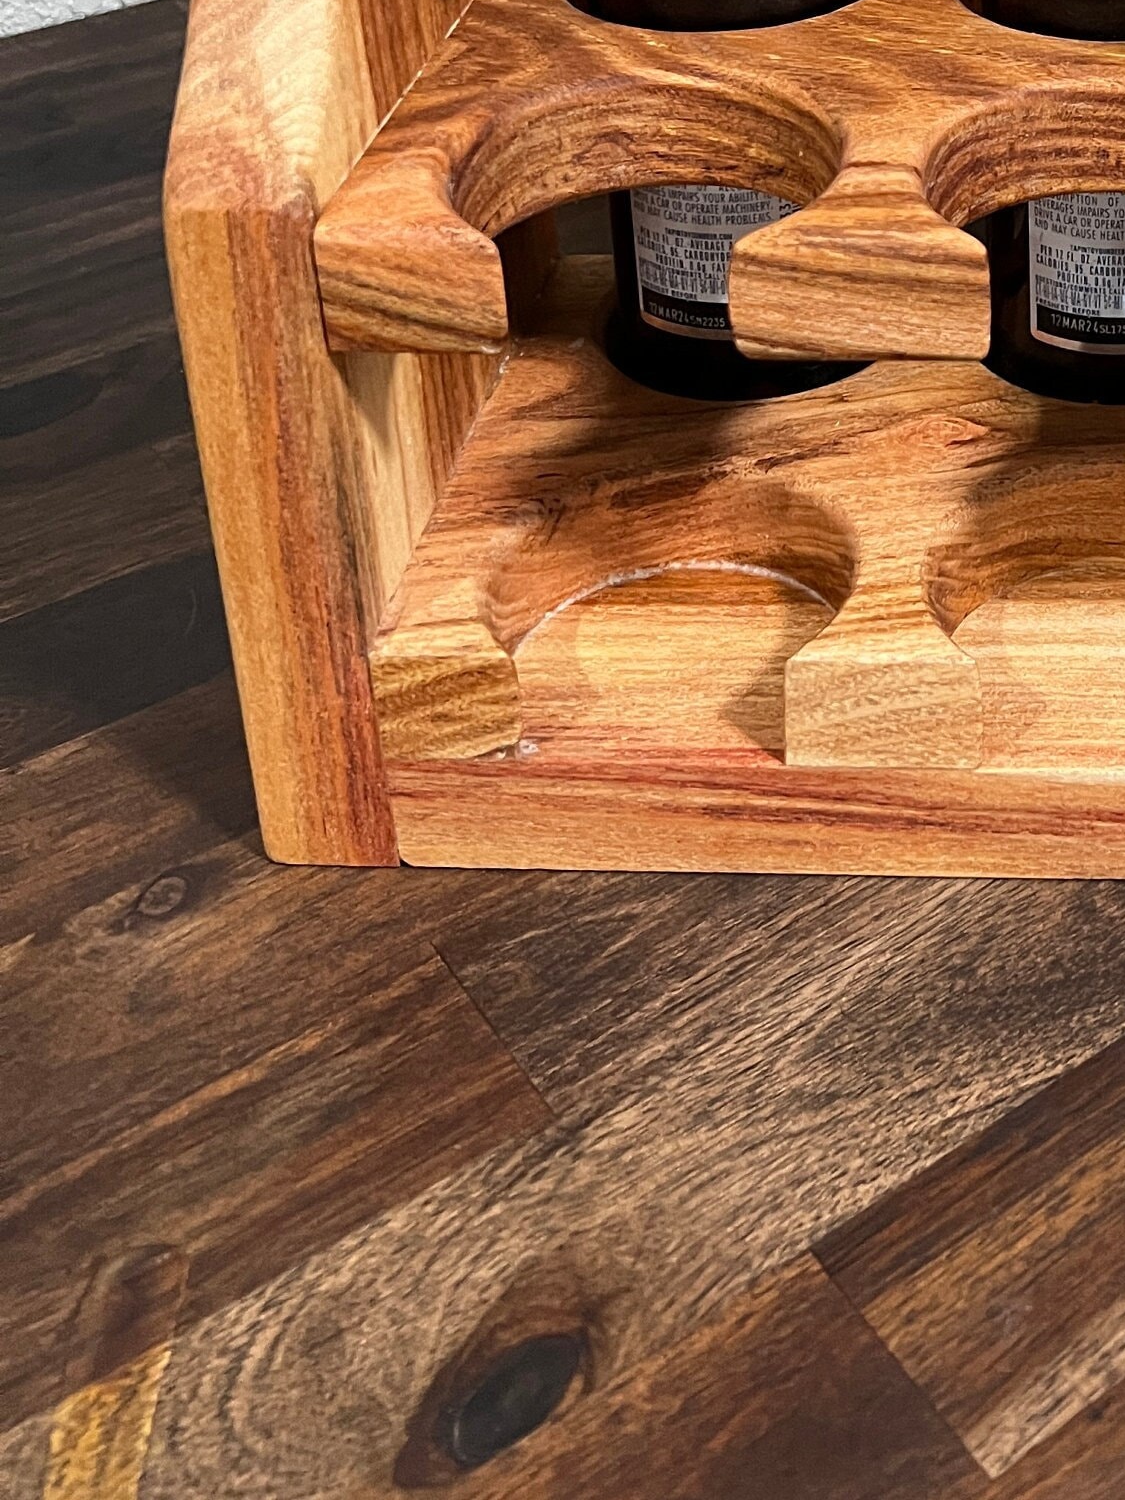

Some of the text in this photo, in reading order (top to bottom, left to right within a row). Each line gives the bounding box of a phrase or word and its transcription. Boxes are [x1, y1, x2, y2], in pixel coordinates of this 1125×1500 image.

[704, 193, 725, 203] YOUR
[729, 190, 759, 203] ABILITY
[1108, 197, 1120, 207] OF
[672, 201, 682, 211] OR
[685, 202, 719, 214] OPERATE
[1077, 206, 1110, 218] IMPAIRS
[664, 209, 688, 223] CAUSE
[691, 214, 721, 226] HEALTH
[1056, 212, 1061, 223] A
[1064, 214, 1078, 225] CAR
[1080, 218, 1091, 228] OR
[1034, 217, 1049, 230] AND
[1051, 222, 1067, 235] MAY
[1071, 227, 1096, 240] CAUSE
[690, 239, 724, 250] AVERAGE
[1072, 307, 1100, 317] BEFORE
